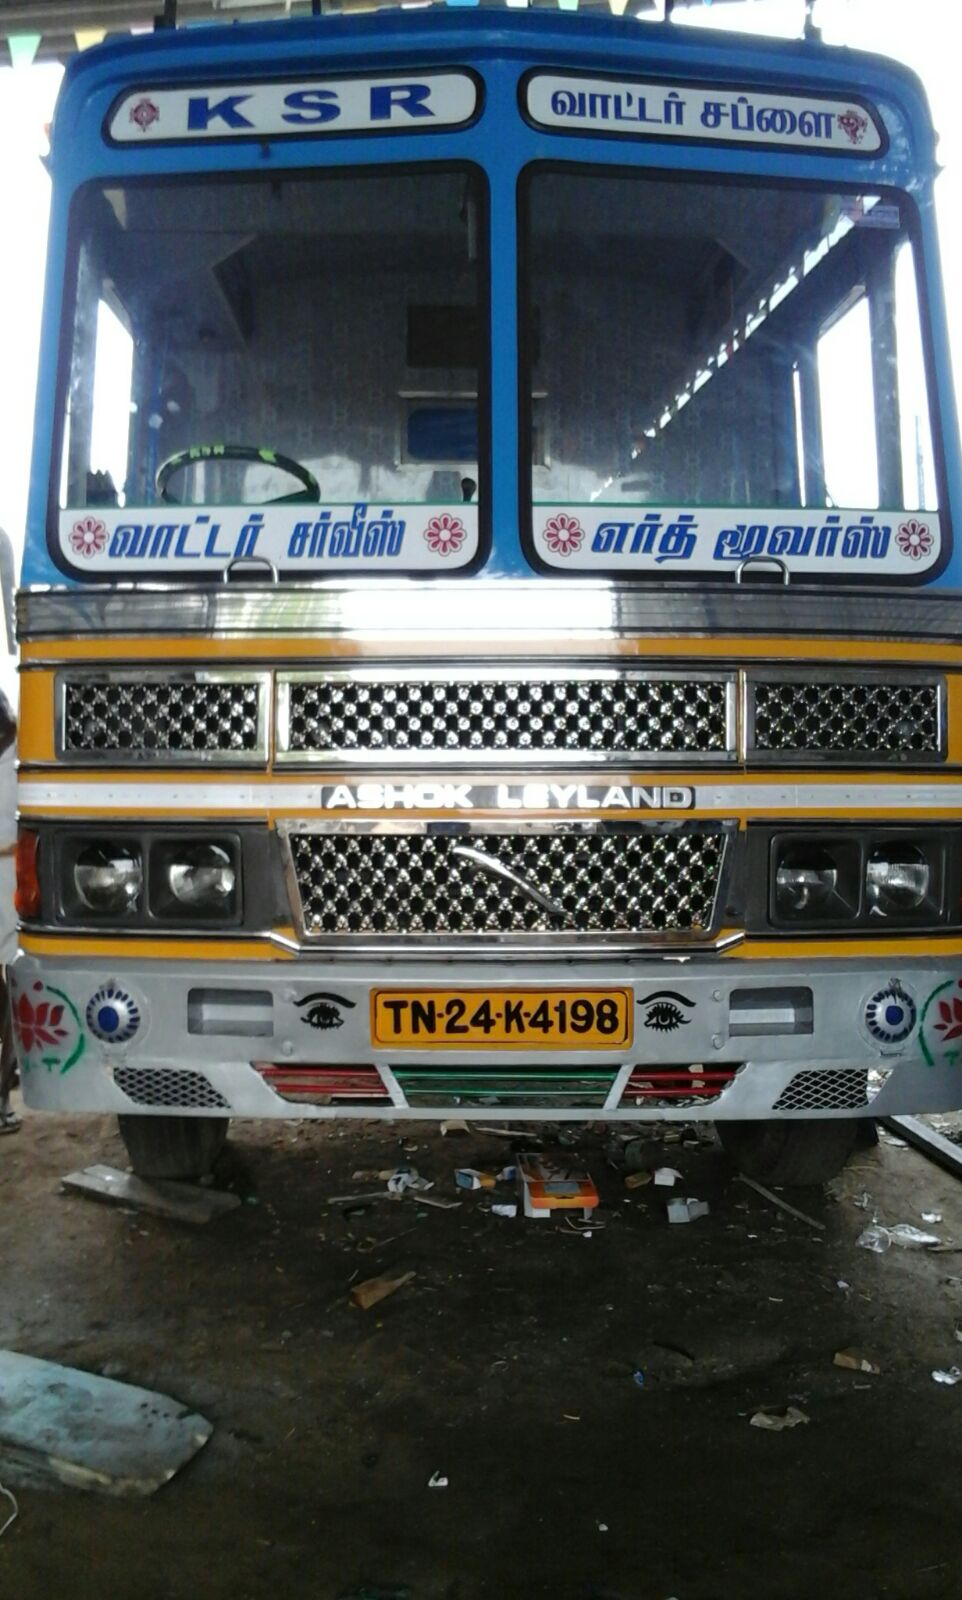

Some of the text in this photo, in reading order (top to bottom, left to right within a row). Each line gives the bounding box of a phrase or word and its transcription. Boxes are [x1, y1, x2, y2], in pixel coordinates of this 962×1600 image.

[551, 89, 835, 139] வாட்டர் சப்ளை
[108, 503, 406, 558] வாட்டர் சர்வீஸ்
[591, 513, 892, 563] எர்த் மூவர்ஸ்
[326, 783, 692, 809] ASHOK LEYLAND
